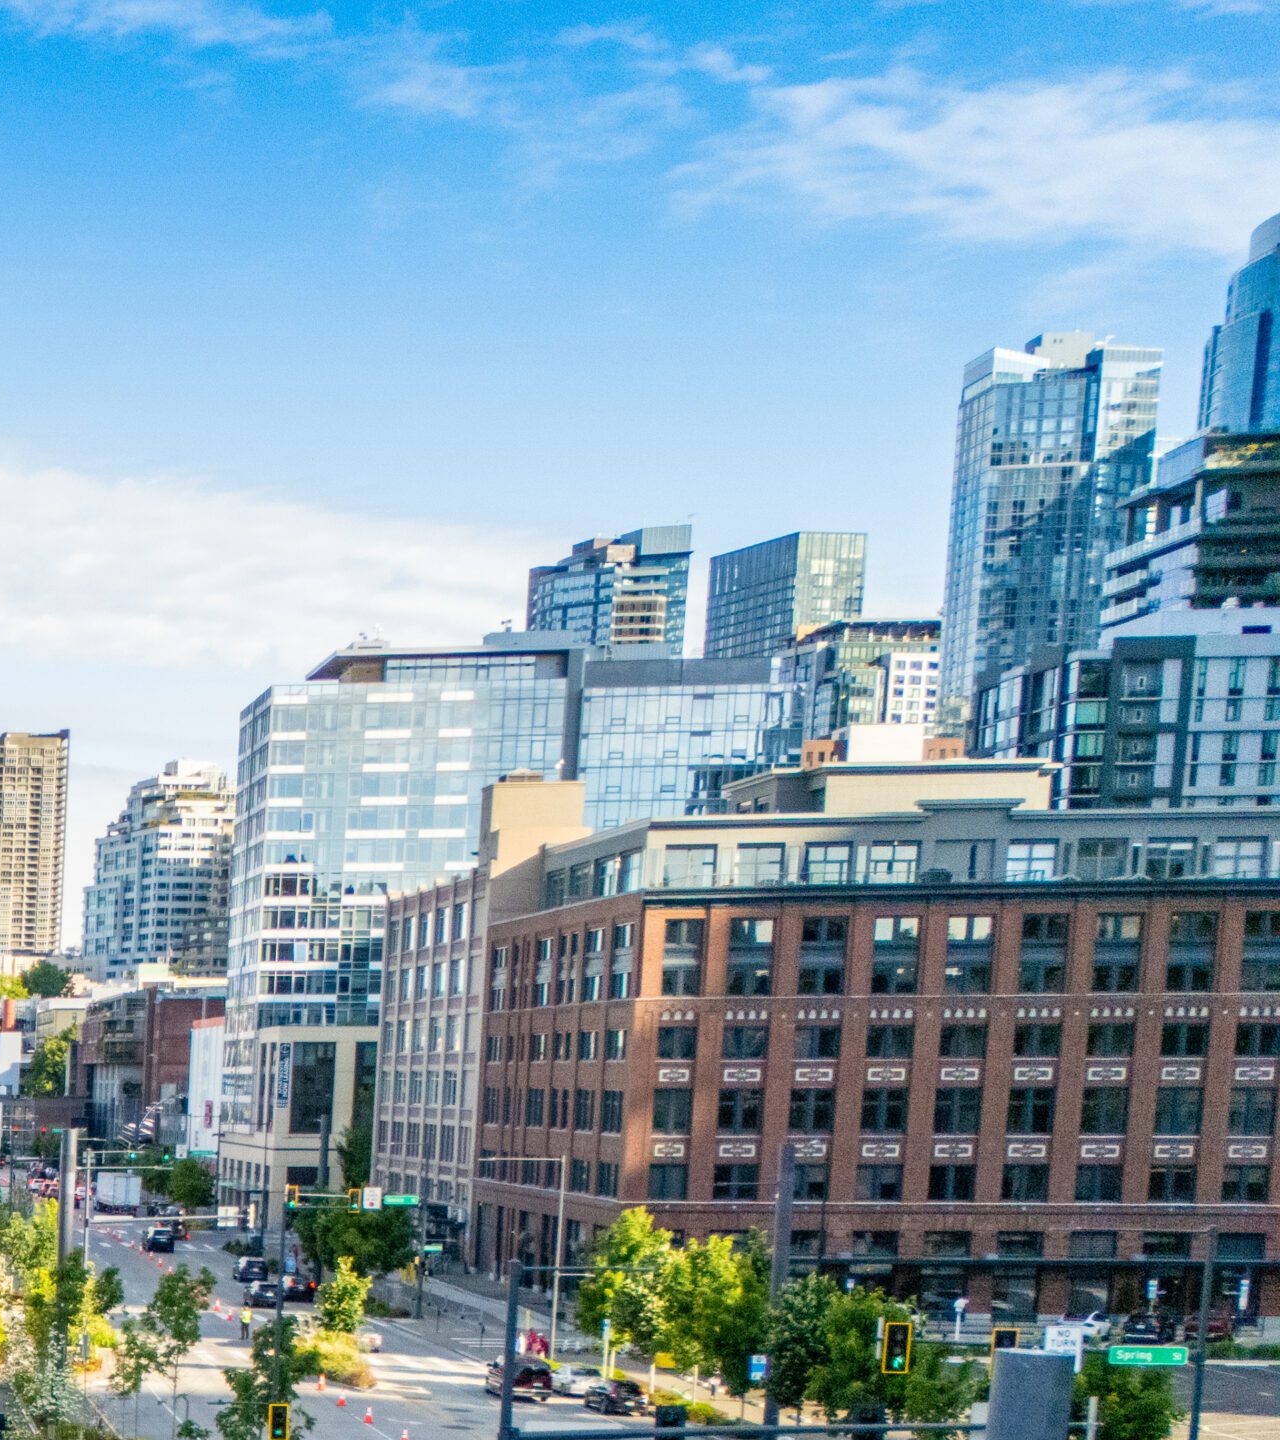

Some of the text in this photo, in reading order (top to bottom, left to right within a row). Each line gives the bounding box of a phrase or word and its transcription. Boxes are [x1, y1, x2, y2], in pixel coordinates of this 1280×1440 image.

[1057, 1329, 1071, 1338] NO
[1051, 1339, 1077, 1348] TURN
[1116, 1350, 1183, 1362] Spring St
